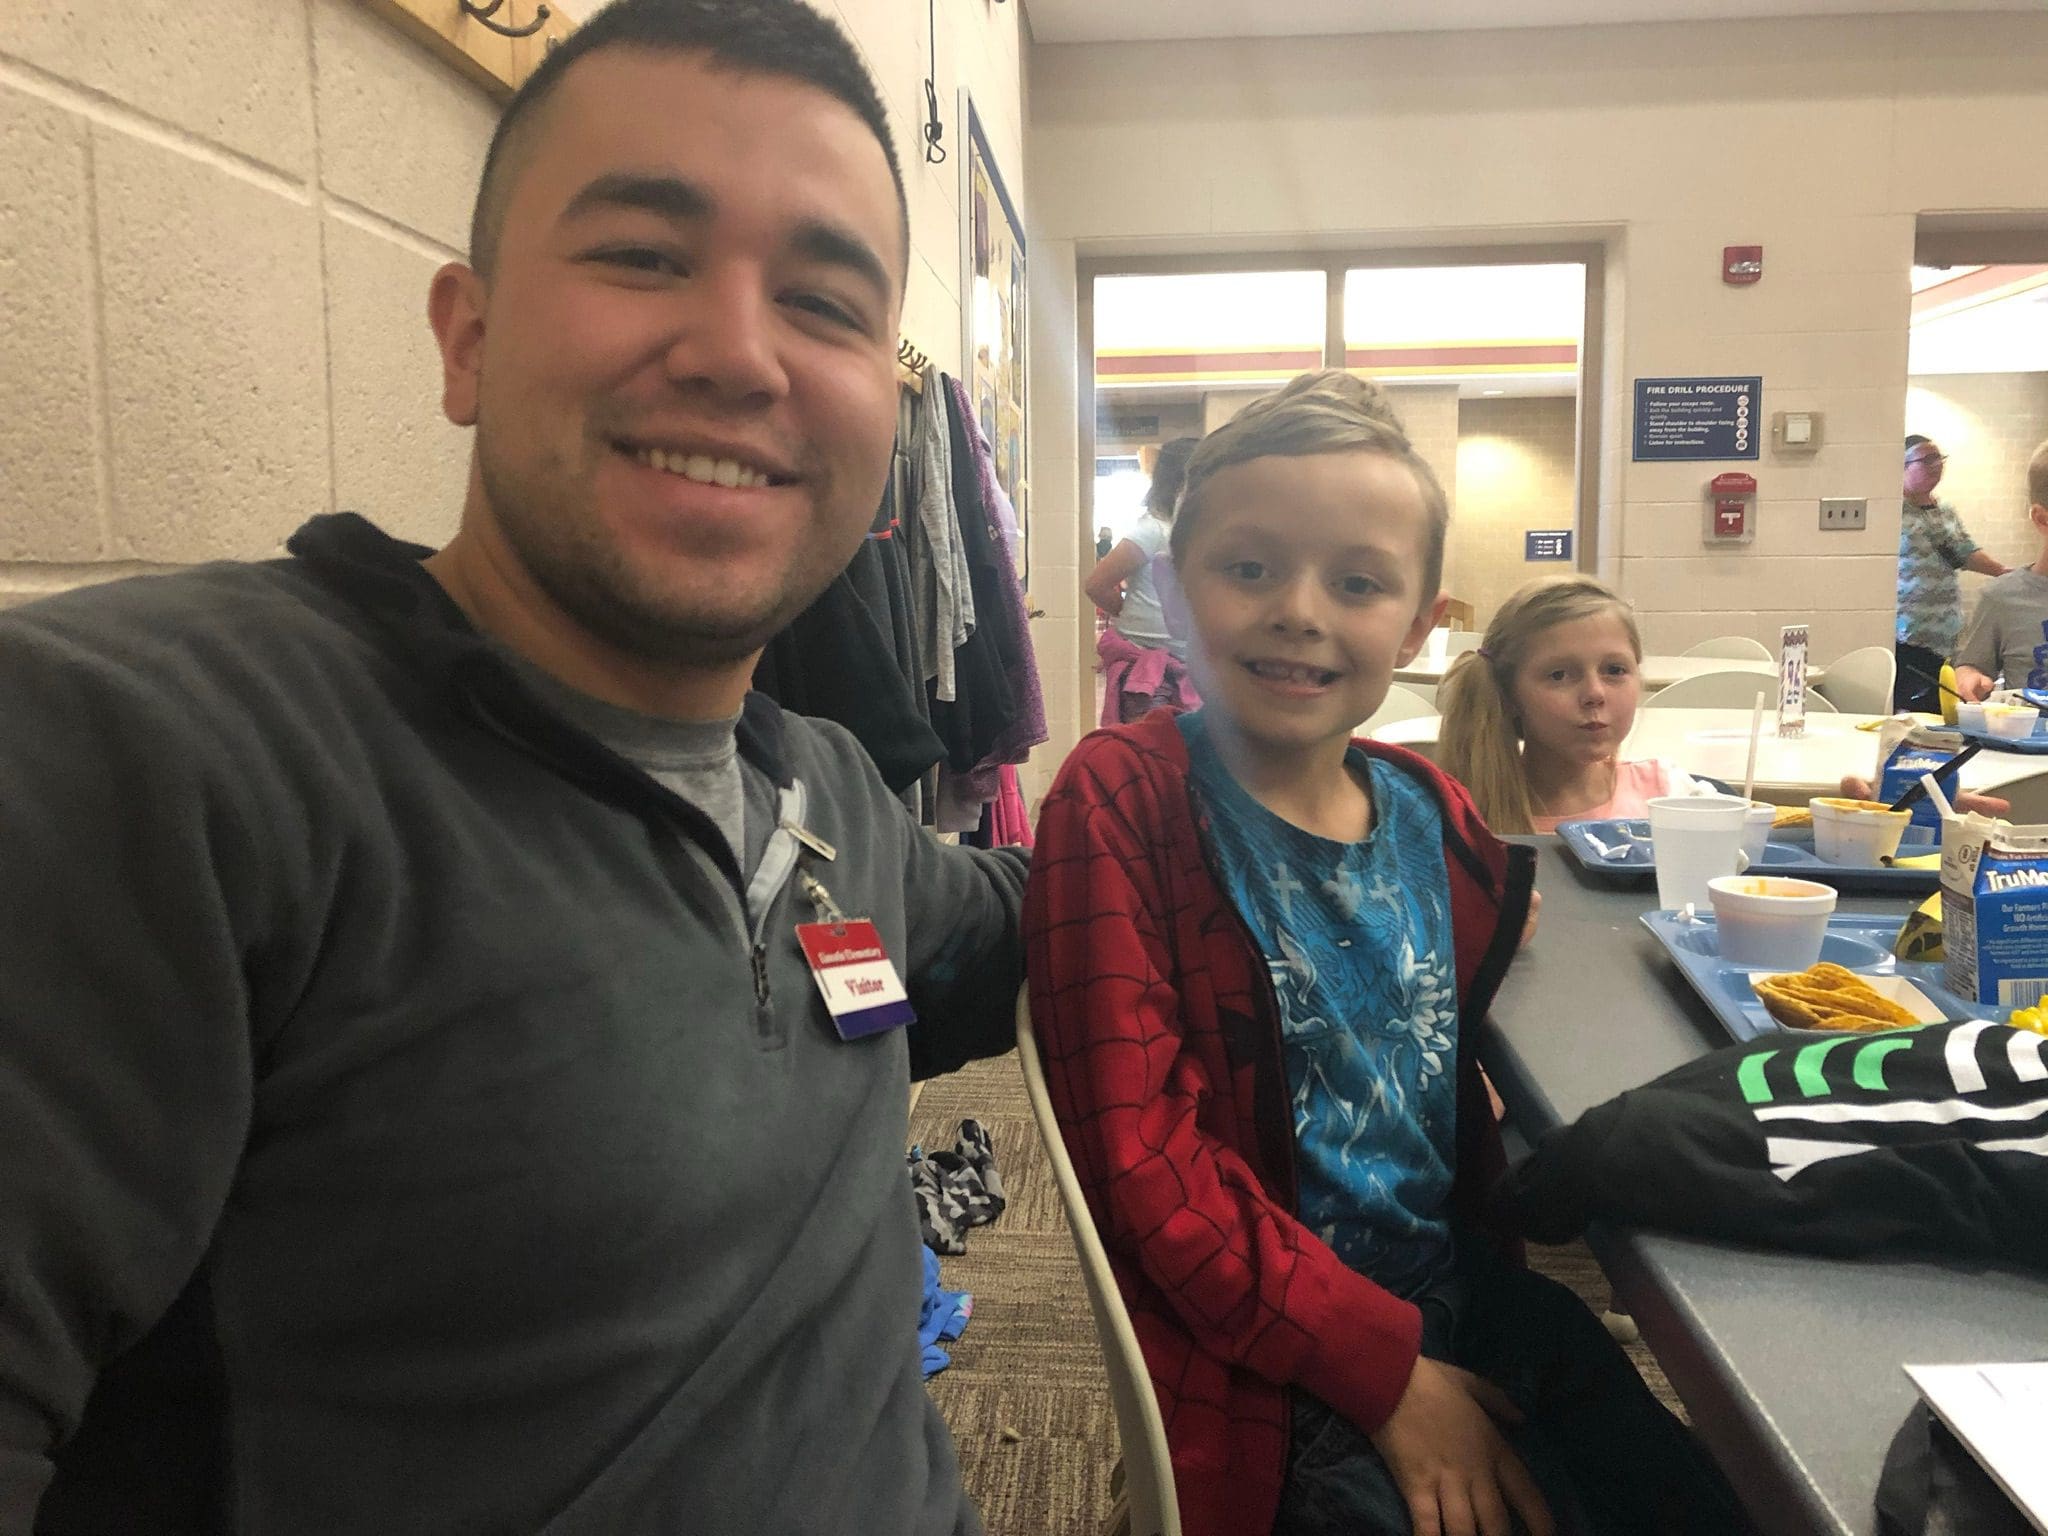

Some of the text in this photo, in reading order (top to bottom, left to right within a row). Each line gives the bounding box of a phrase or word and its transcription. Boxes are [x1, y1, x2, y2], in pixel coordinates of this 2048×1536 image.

[1646, 384, 1750, 394] FIRE DRILL PROCEDURE
[844, 978, 884, 997] Visitor
